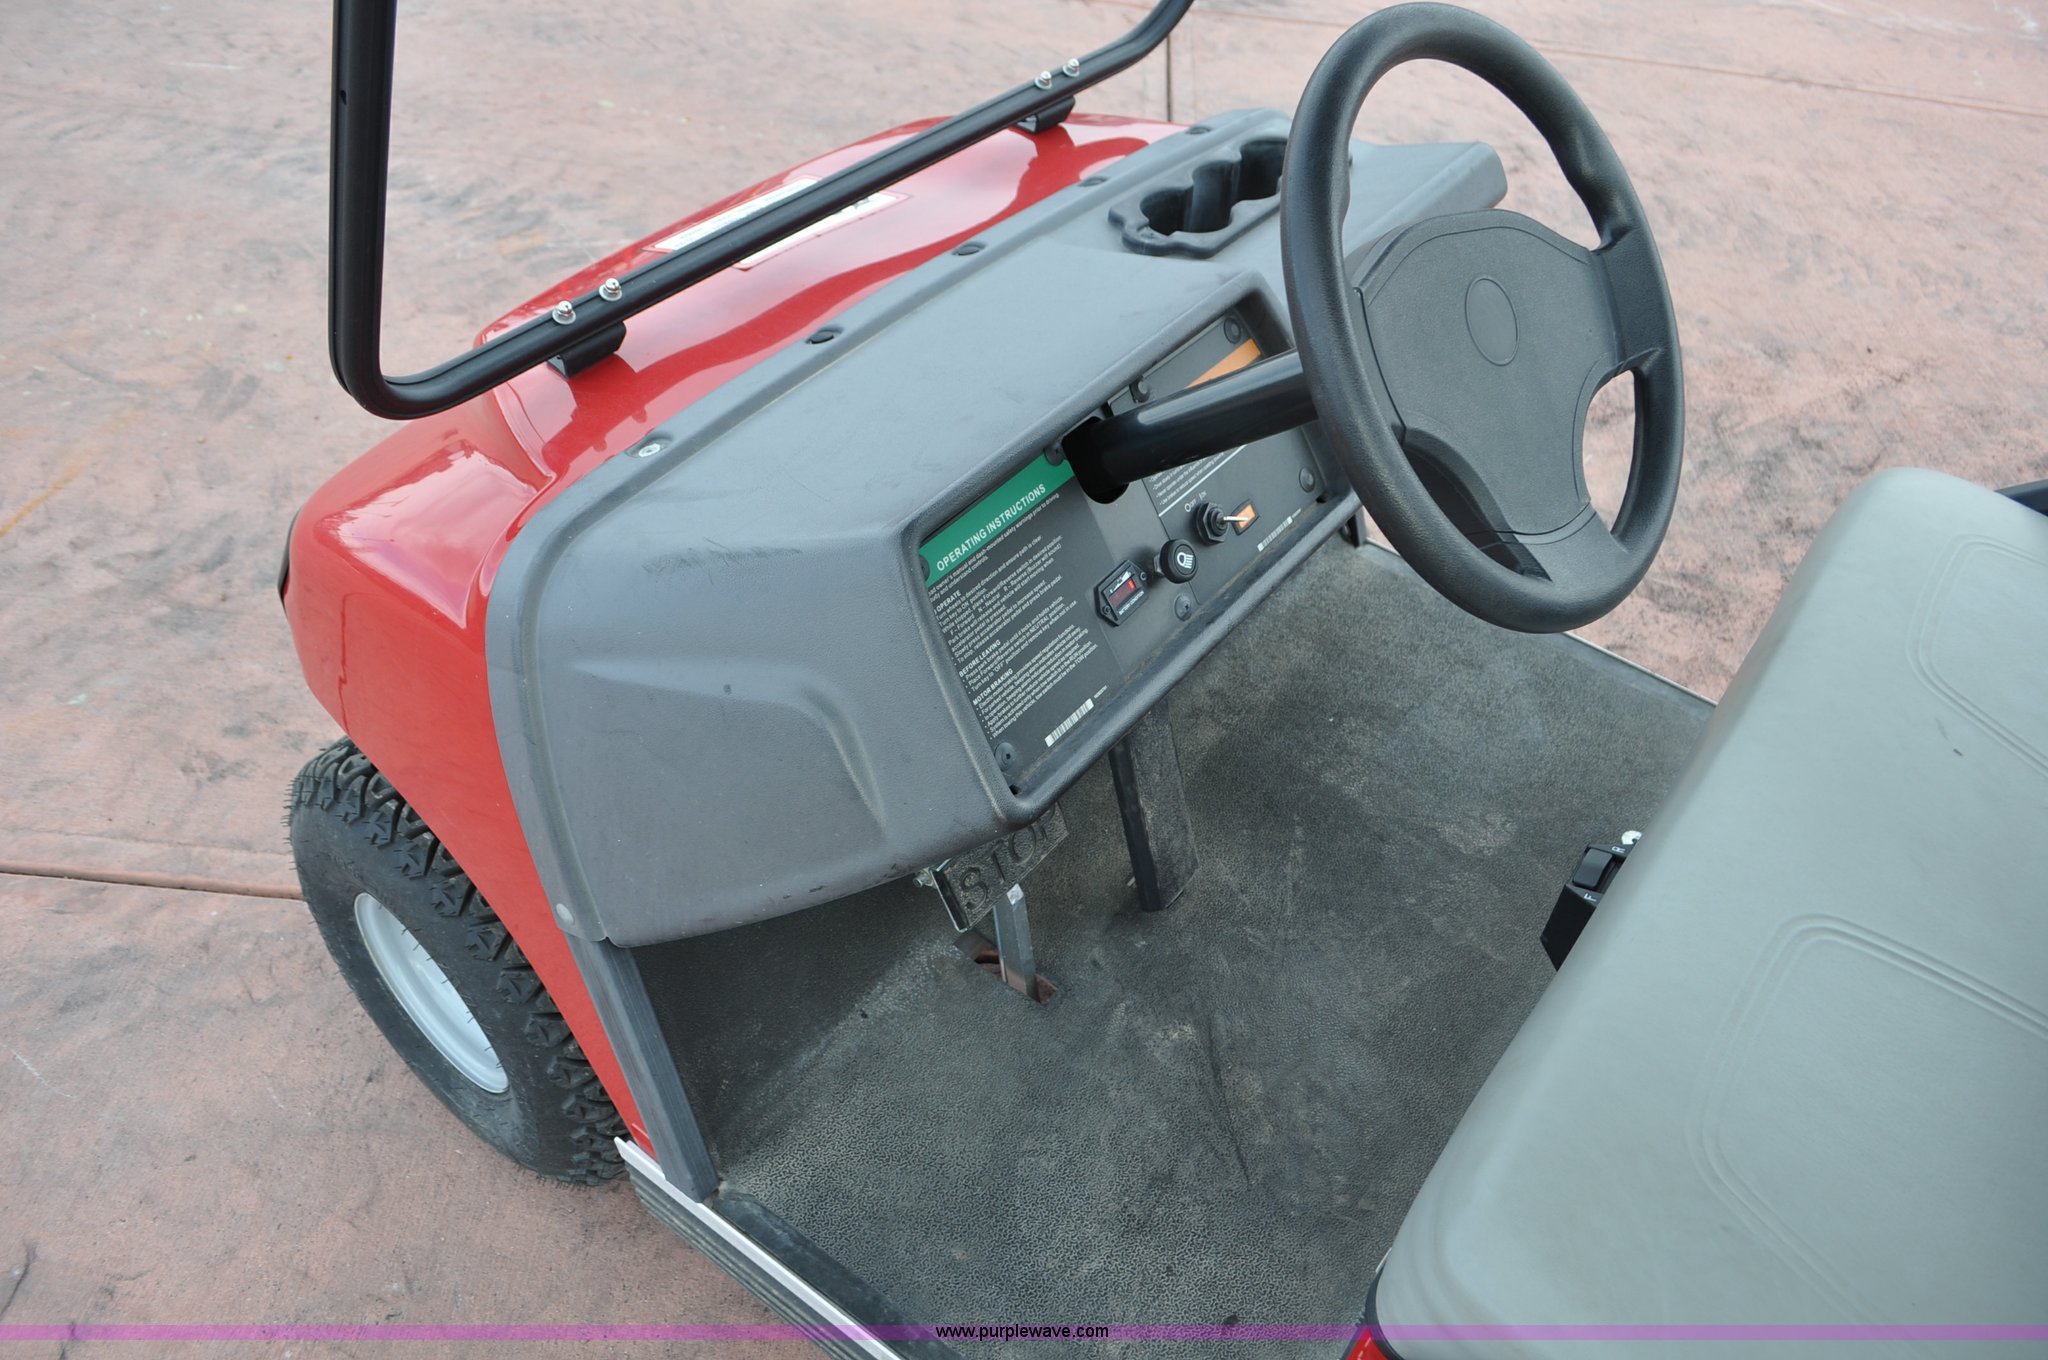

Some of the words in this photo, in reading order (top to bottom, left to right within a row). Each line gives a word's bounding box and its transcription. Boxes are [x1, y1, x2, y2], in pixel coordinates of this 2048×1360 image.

[937, 529, 986, 570] OPERATING
[986, 484, 1045, 533] INSTRUCTIONS
[937, 590, 961, 611] OPERATE
[959, 657, 980, 677] BEFORE
[979, 640, 1000, 660] LEAVING
[973, 687, 991, 705] MOTOR
[991, 669, 1013, 690] BRAKING
[1612, 846, 1625, 854] R
[1584, 893, 1597, 902] F
